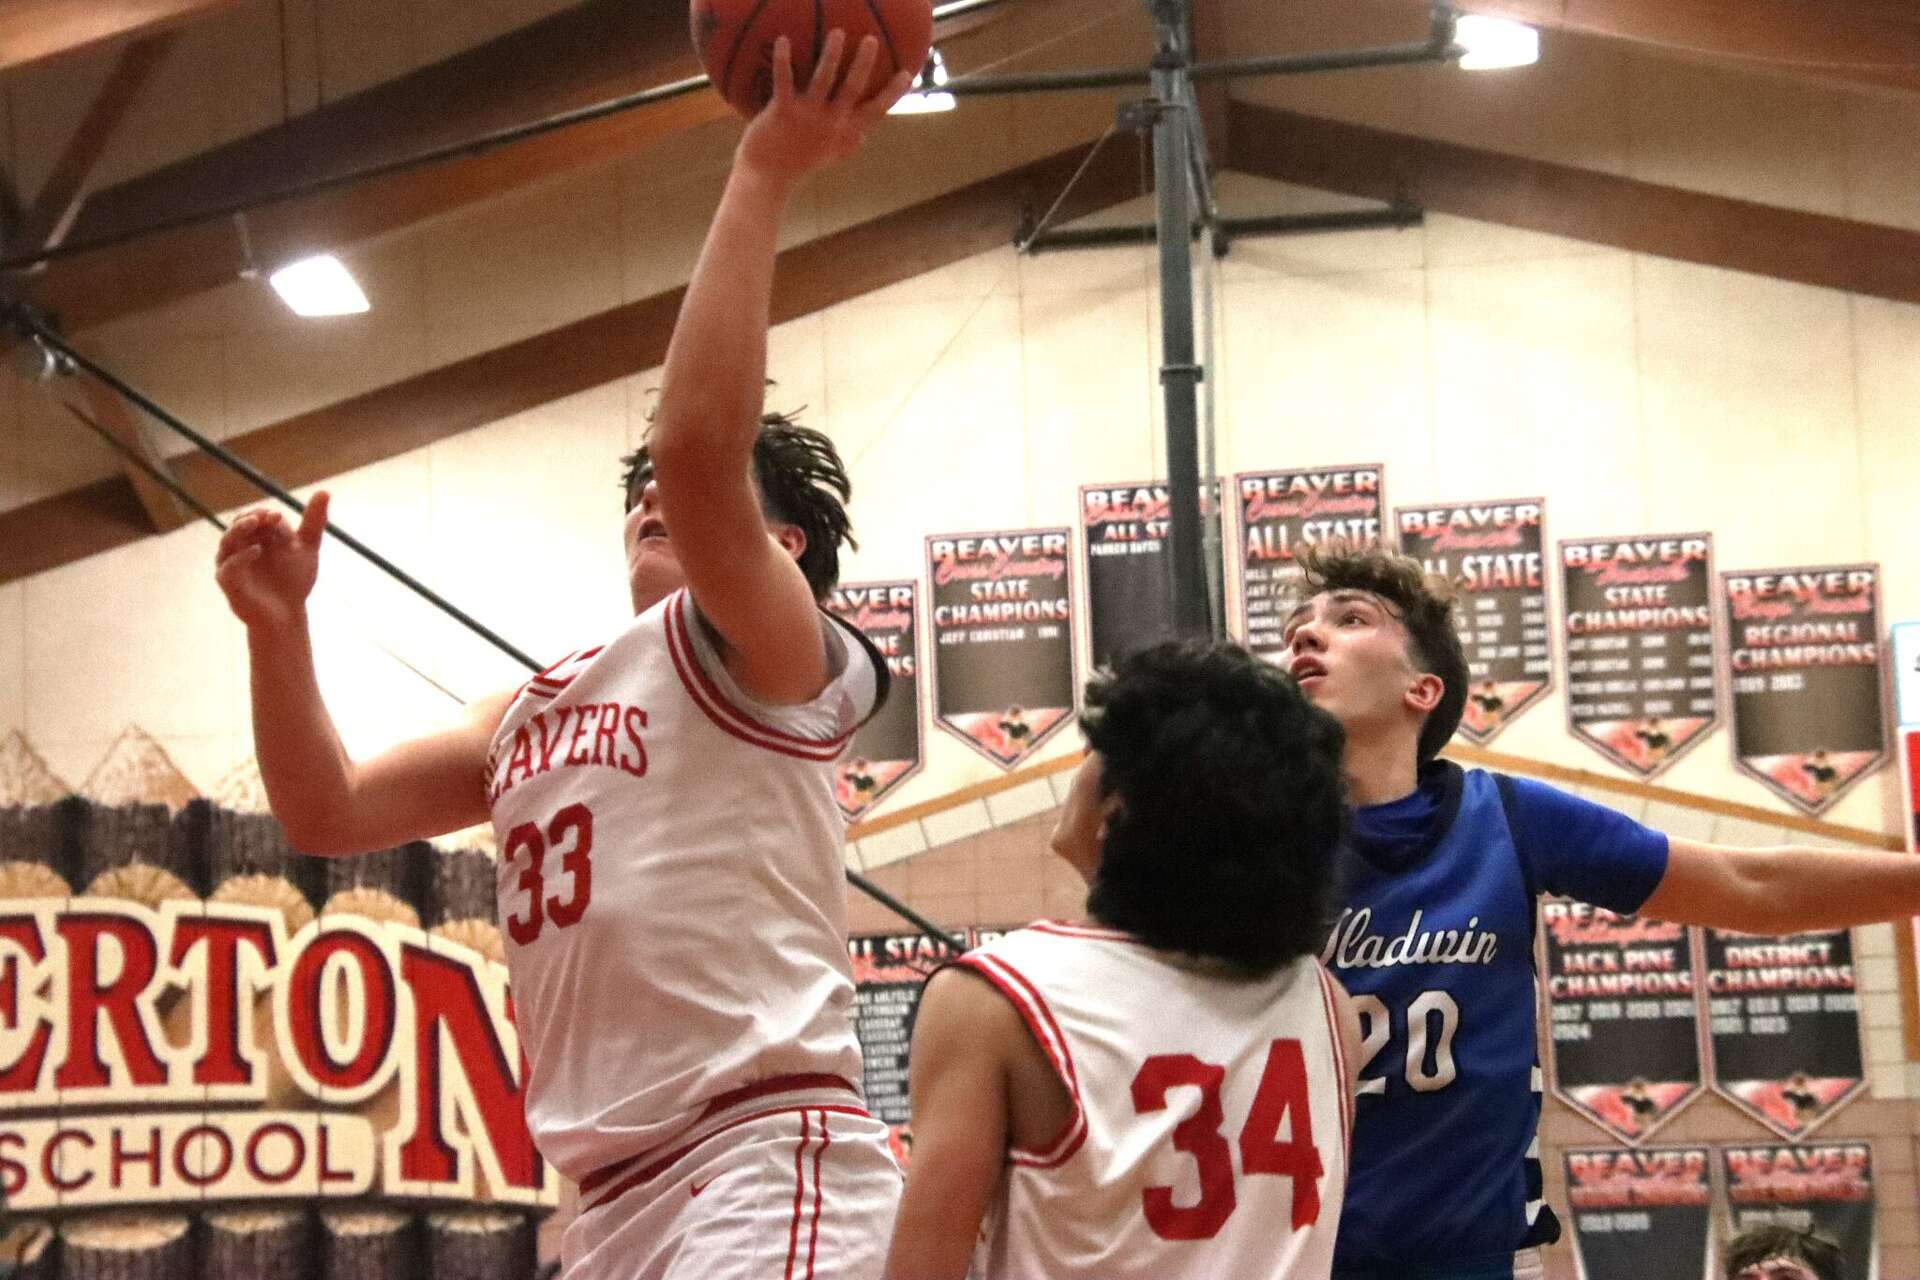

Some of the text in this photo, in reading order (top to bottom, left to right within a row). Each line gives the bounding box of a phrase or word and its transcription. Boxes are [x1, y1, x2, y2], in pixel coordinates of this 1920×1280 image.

[1243, 471, 1378, 501] BEAVER
[1104, 523, 1137, 541] ALL
[1401, 504, 1541, 534] BEAVER
[932, 534, 1066, 562] BEAVER
[1248, 518, 1378, 560] ALL STATE
[1564, 540, 1707, 567] BEAVER
[1462, 552, 1541, 592] STATE
[1728, 571, 1873, 600] BEAVER
[829, 586, 913, 612] AVER
[970, 579, 1029, 601] STATE
[1604, 585, 1667, 608] STATE
[935, 598, 1069, 626] CHAMPIONS
[1567, 606, 1709, 634] CHAMPIONS
[1744, 622, 1857, 647] REGIONAL
[1732, 643, 1876, 672] CHAMPIONS
[486, 703, 648, 803] AVERS
[504, 802, 593, 946] 33
[1563, 949, 1674, 974] JACK PINE
[1725, 943, 1830, 968] DISTRICT
[1550, 971, 1692, 999] CHAMPIONS
[1709, 966, 1855, 993] CHAMPIONS
[1350, 989, 1459, 1092] 20
[1131, 1038, 1324, 1241] 34
[0, 1122, 354, 1196] SCHOOL
